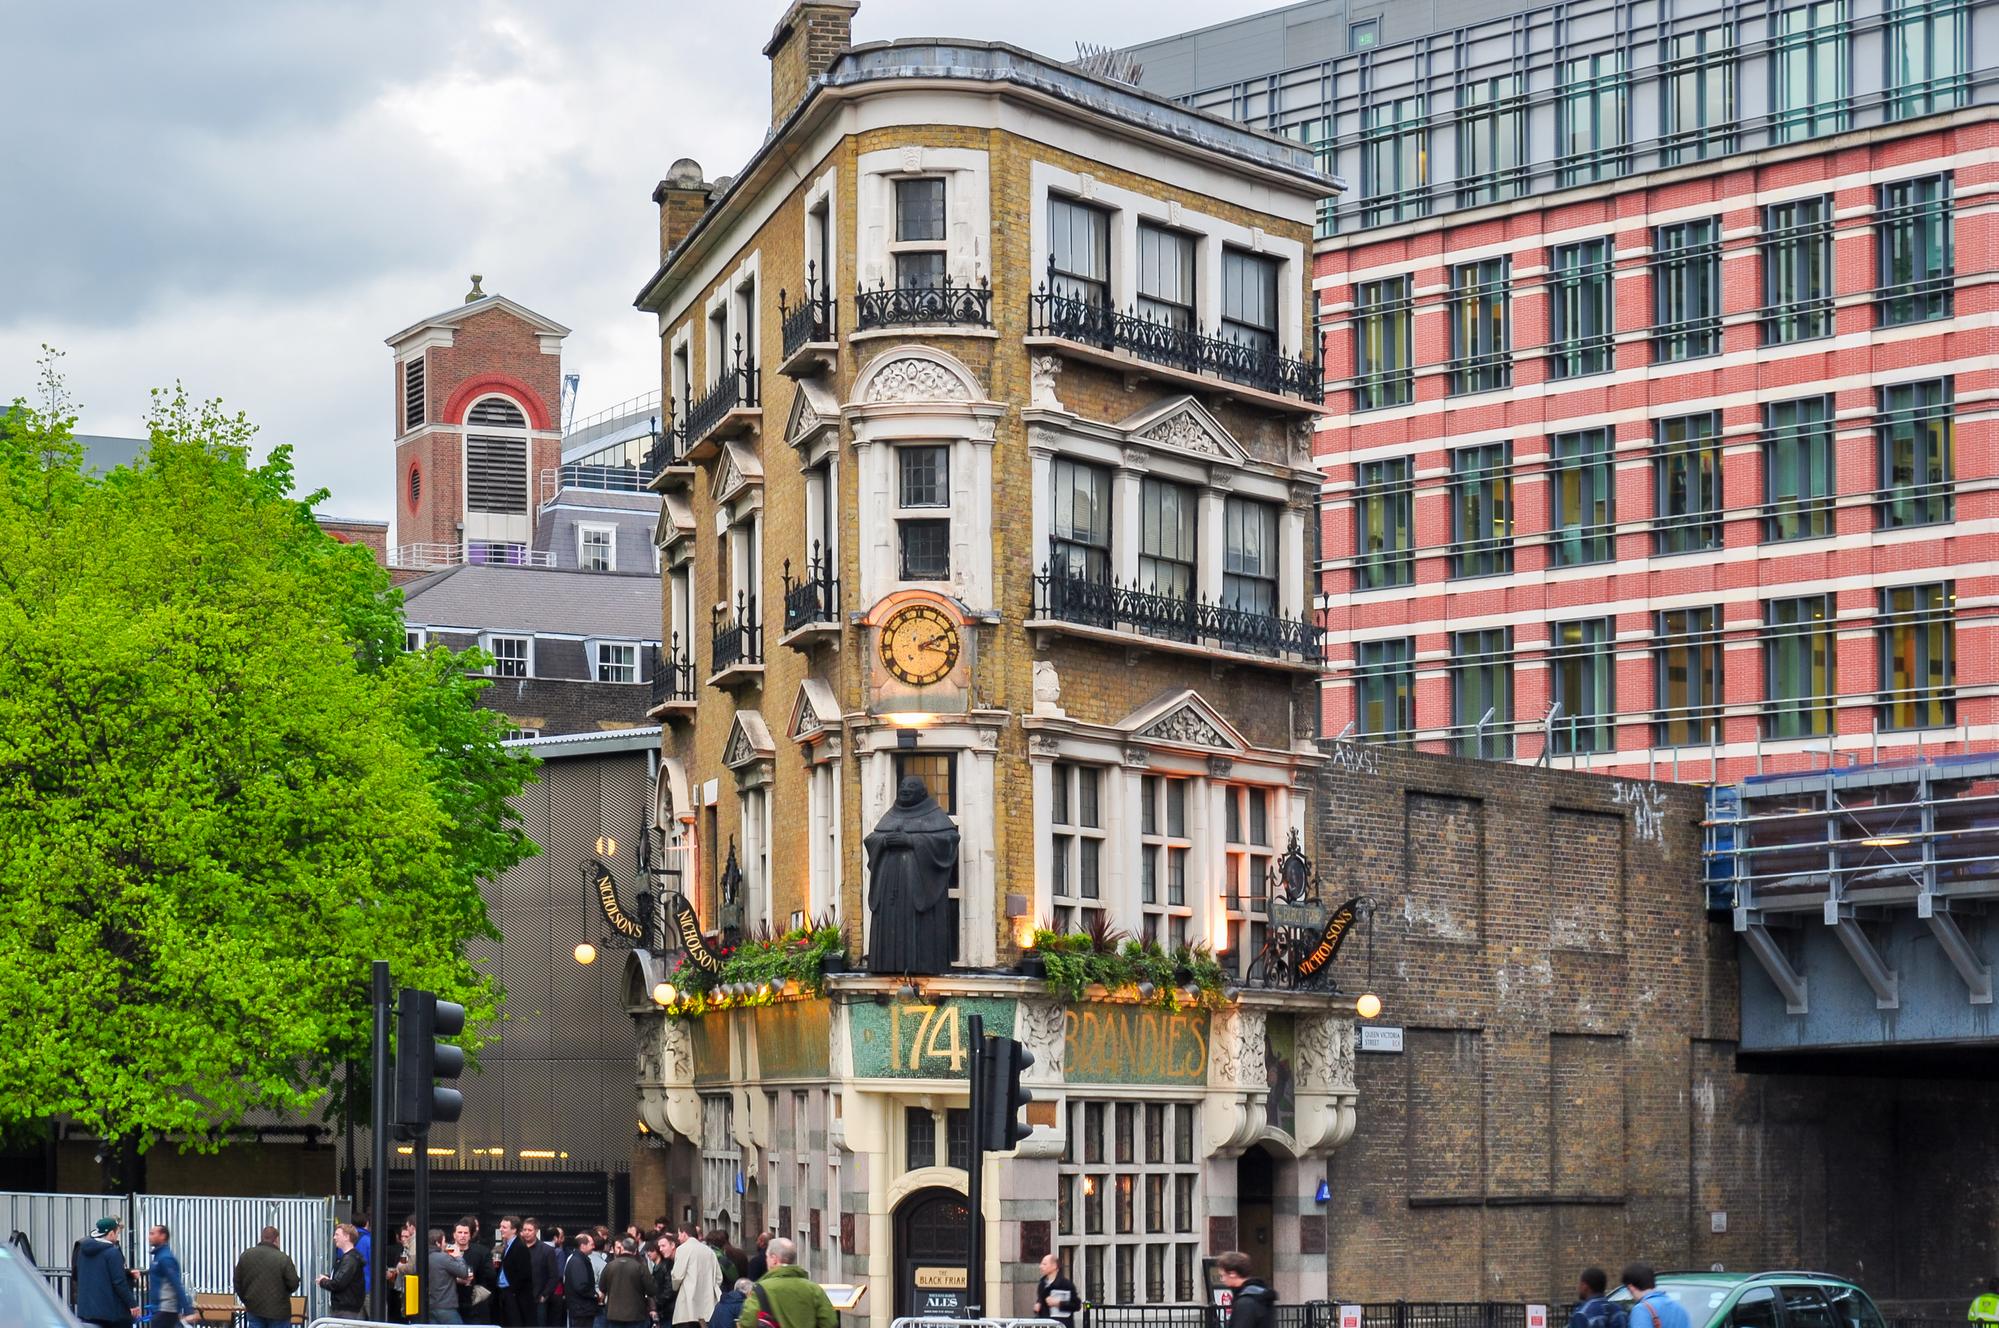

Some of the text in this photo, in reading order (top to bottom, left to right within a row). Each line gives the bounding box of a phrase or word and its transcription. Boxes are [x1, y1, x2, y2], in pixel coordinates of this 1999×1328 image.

[890, 1004, 967, 1071] 174
[1062, 1010, 1207, 1077] BRANDIES
[919, 1276, 966, 1285] BLACK FRIAR
[925, 1297, 958, 1307] ALES
